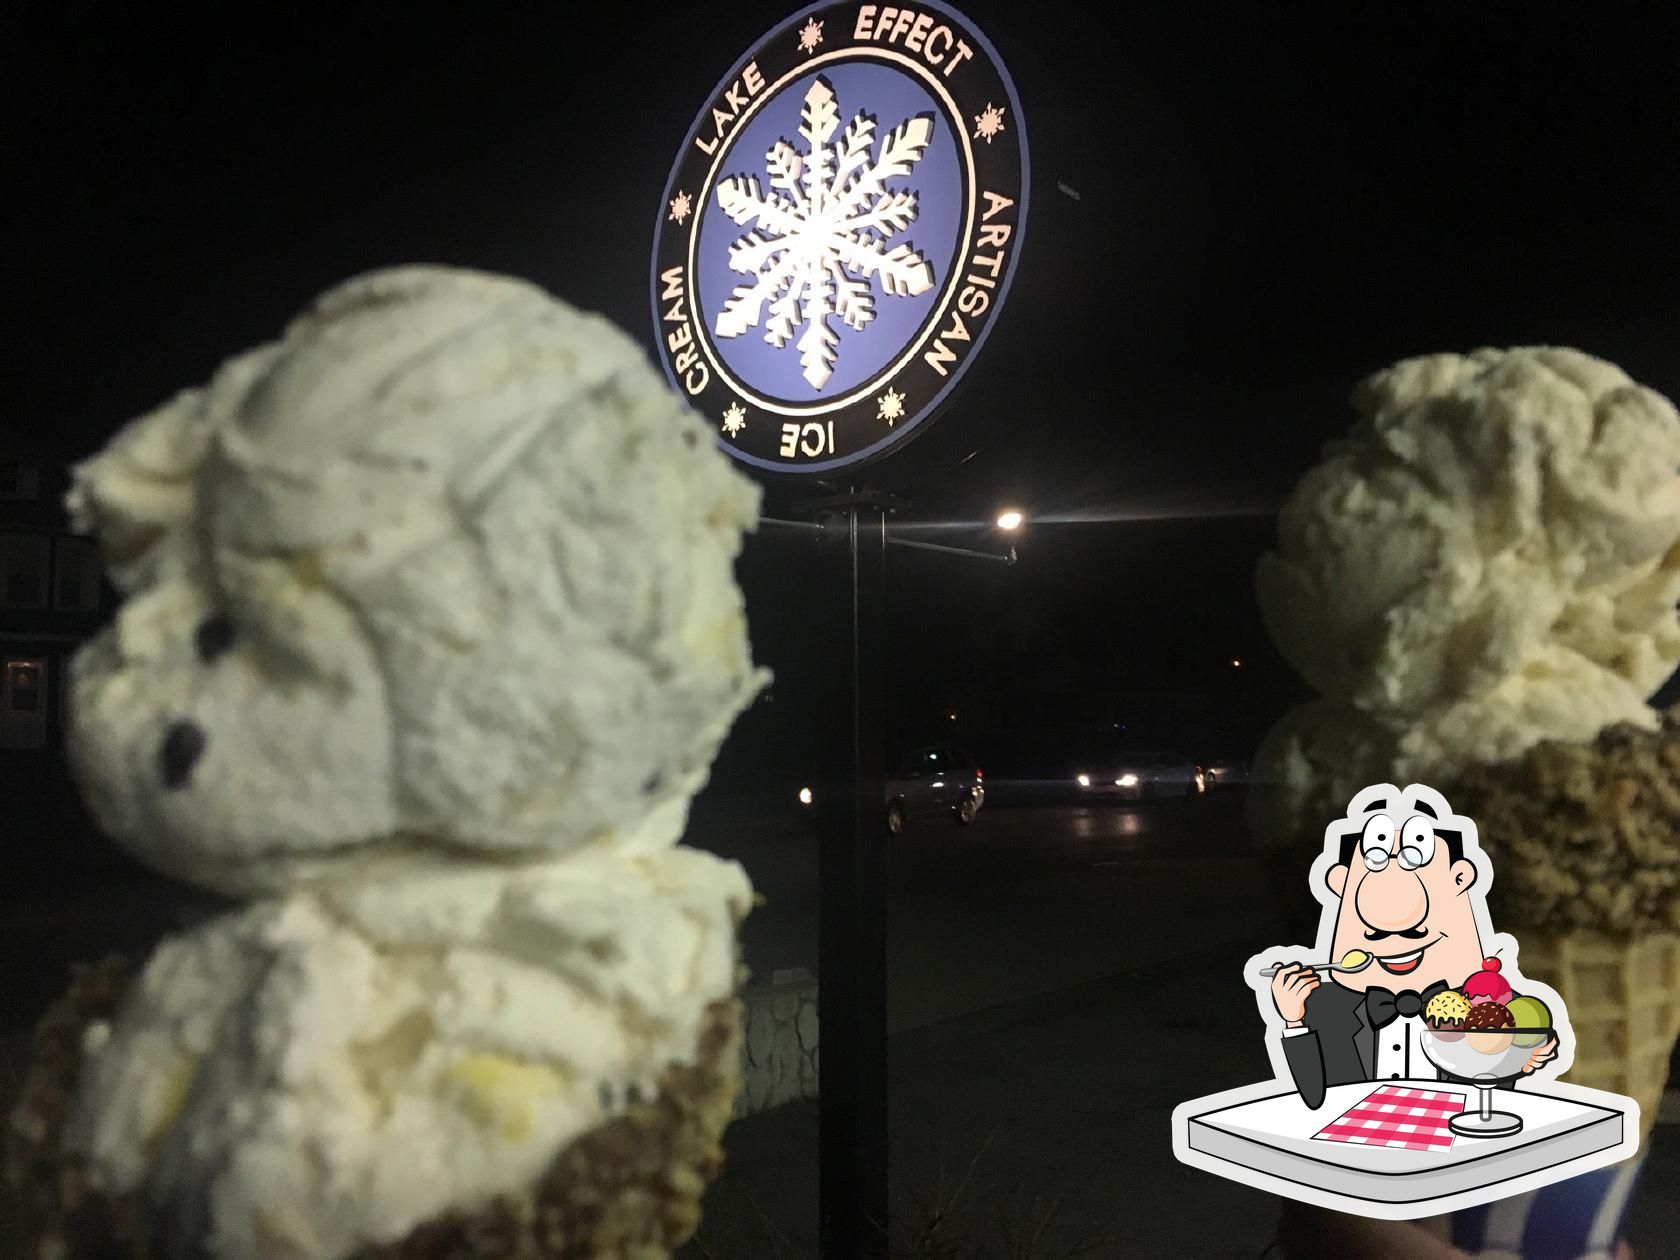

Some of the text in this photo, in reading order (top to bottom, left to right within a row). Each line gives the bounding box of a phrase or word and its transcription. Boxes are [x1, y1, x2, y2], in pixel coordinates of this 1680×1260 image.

[661, 5, 1014, 457] LAKE EFFECT ARTISAN ICE CREAM
